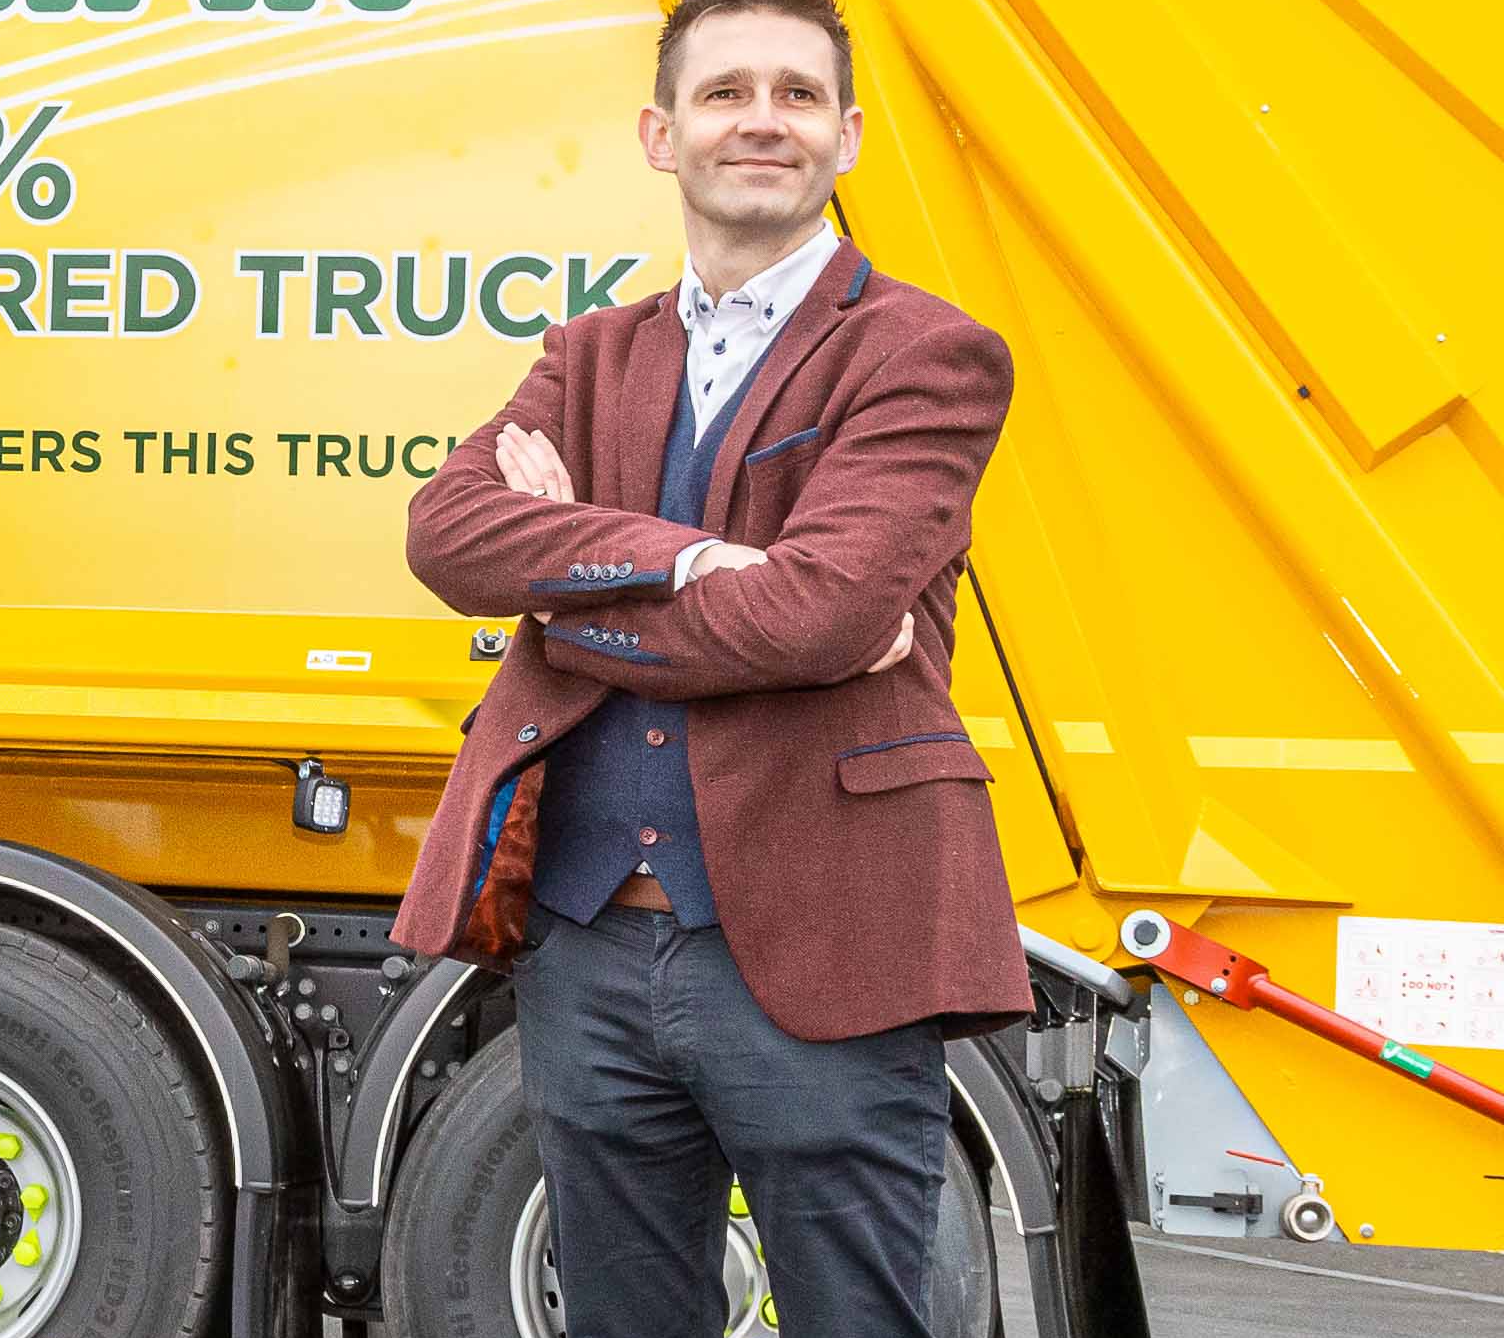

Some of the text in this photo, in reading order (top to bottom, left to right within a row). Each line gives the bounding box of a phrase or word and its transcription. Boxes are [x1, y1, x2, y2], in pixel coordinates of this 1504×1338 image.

[239, 255, 640, 338] TRUCK
[123, 431, 255, 475] THIS
[277, 434, 456, 478] TRUC
[1409, 981, 1448, 991] DO NOT
[447, 1112, 532, 1300] EcoRegiona
